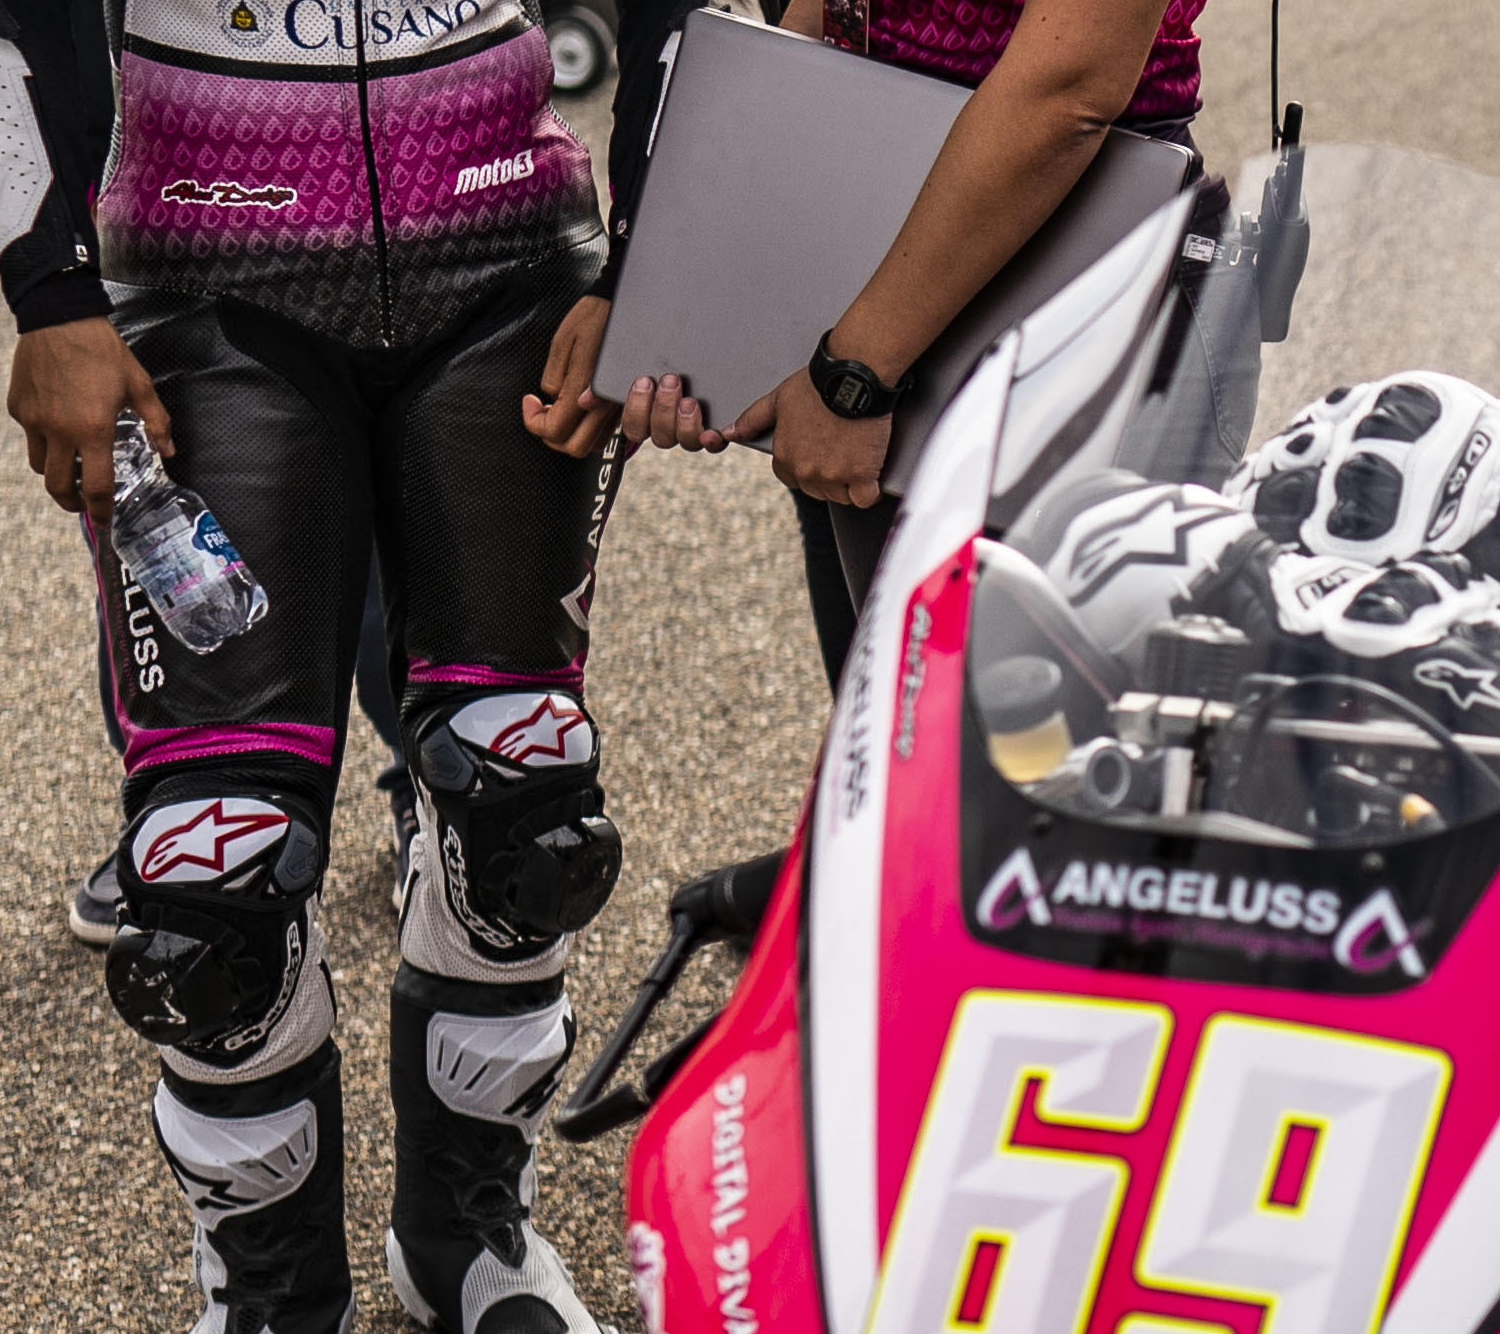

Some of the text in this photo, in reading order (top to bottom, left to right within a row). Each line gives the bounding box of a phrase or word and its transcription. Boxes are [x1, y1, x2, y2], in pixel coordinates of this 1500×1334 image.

[454, 149, 535, 196] moto3
[1051, 859, 1343, 936] ANGELUSS
[709, 1072, 749, 1237] DIGITAL
